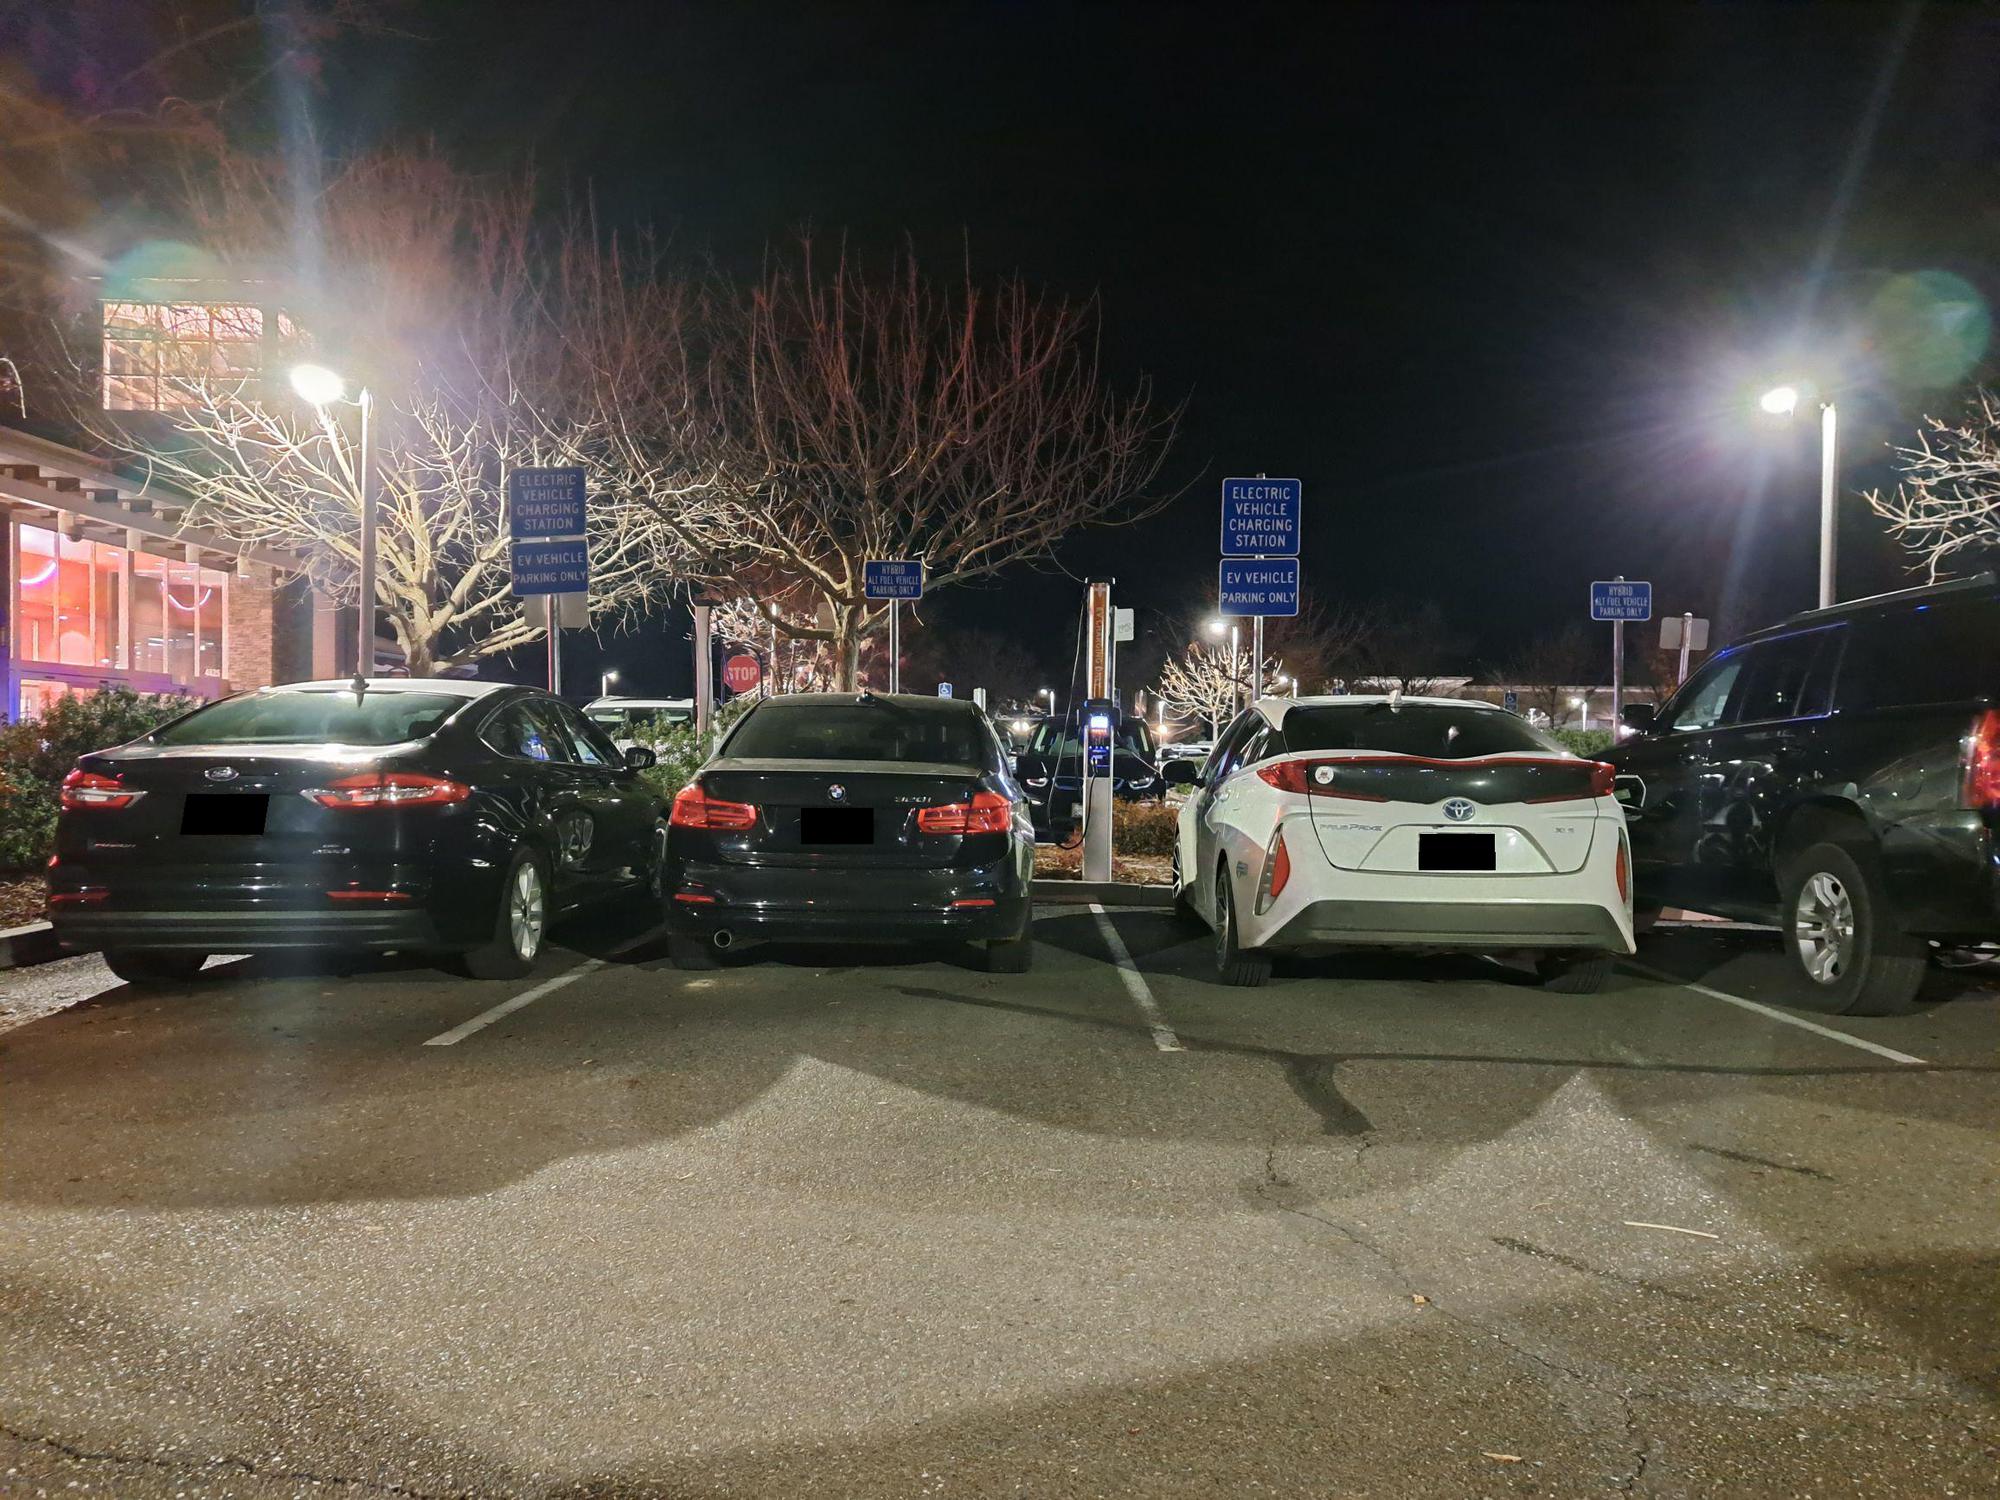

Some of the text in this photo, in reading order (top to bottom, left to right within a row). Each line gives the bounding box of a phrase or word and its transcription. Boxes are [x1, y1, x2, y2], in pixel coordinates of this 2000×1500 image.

[519, 474, 577, 487] ELECTRIC
[522, 488, 574, 501] VEHICLE
[1232, 486, 1291, 500] ELECTRIC
[516, 502, 579, 516] CHARGING
[1235, 503, 1287, 516] VEHICLE
[524, 517, 574, 530] STATION
[1229, 518, 1293, 531] CHARGING
[1235, 534, 1286, 547] STATION
[518, 551, 585, 567] EV VEHICLE
[881, 564, 905, 574] HYBRID
[513, 570, 587, 584] PARKING ONLY
[880, 575, 894, 585] FUEL
[896, 575, 919, 585] VEHICLE
[1227, 571, 1294, 584] EV VEHICLE
[872, 585, 914, 595] PARKING ONLY
[1608, 586, 1633, 596] HYBRID
[1221, 592, 1296, 604] PARKING ONLY
[1607, 597, 1622, 606] FUEL
[1623, 597, 1648, 607] VEHICLE
[1599, 607, 1642, 617] PARKING ONLY
[728, 666, 758, 681] STOP
